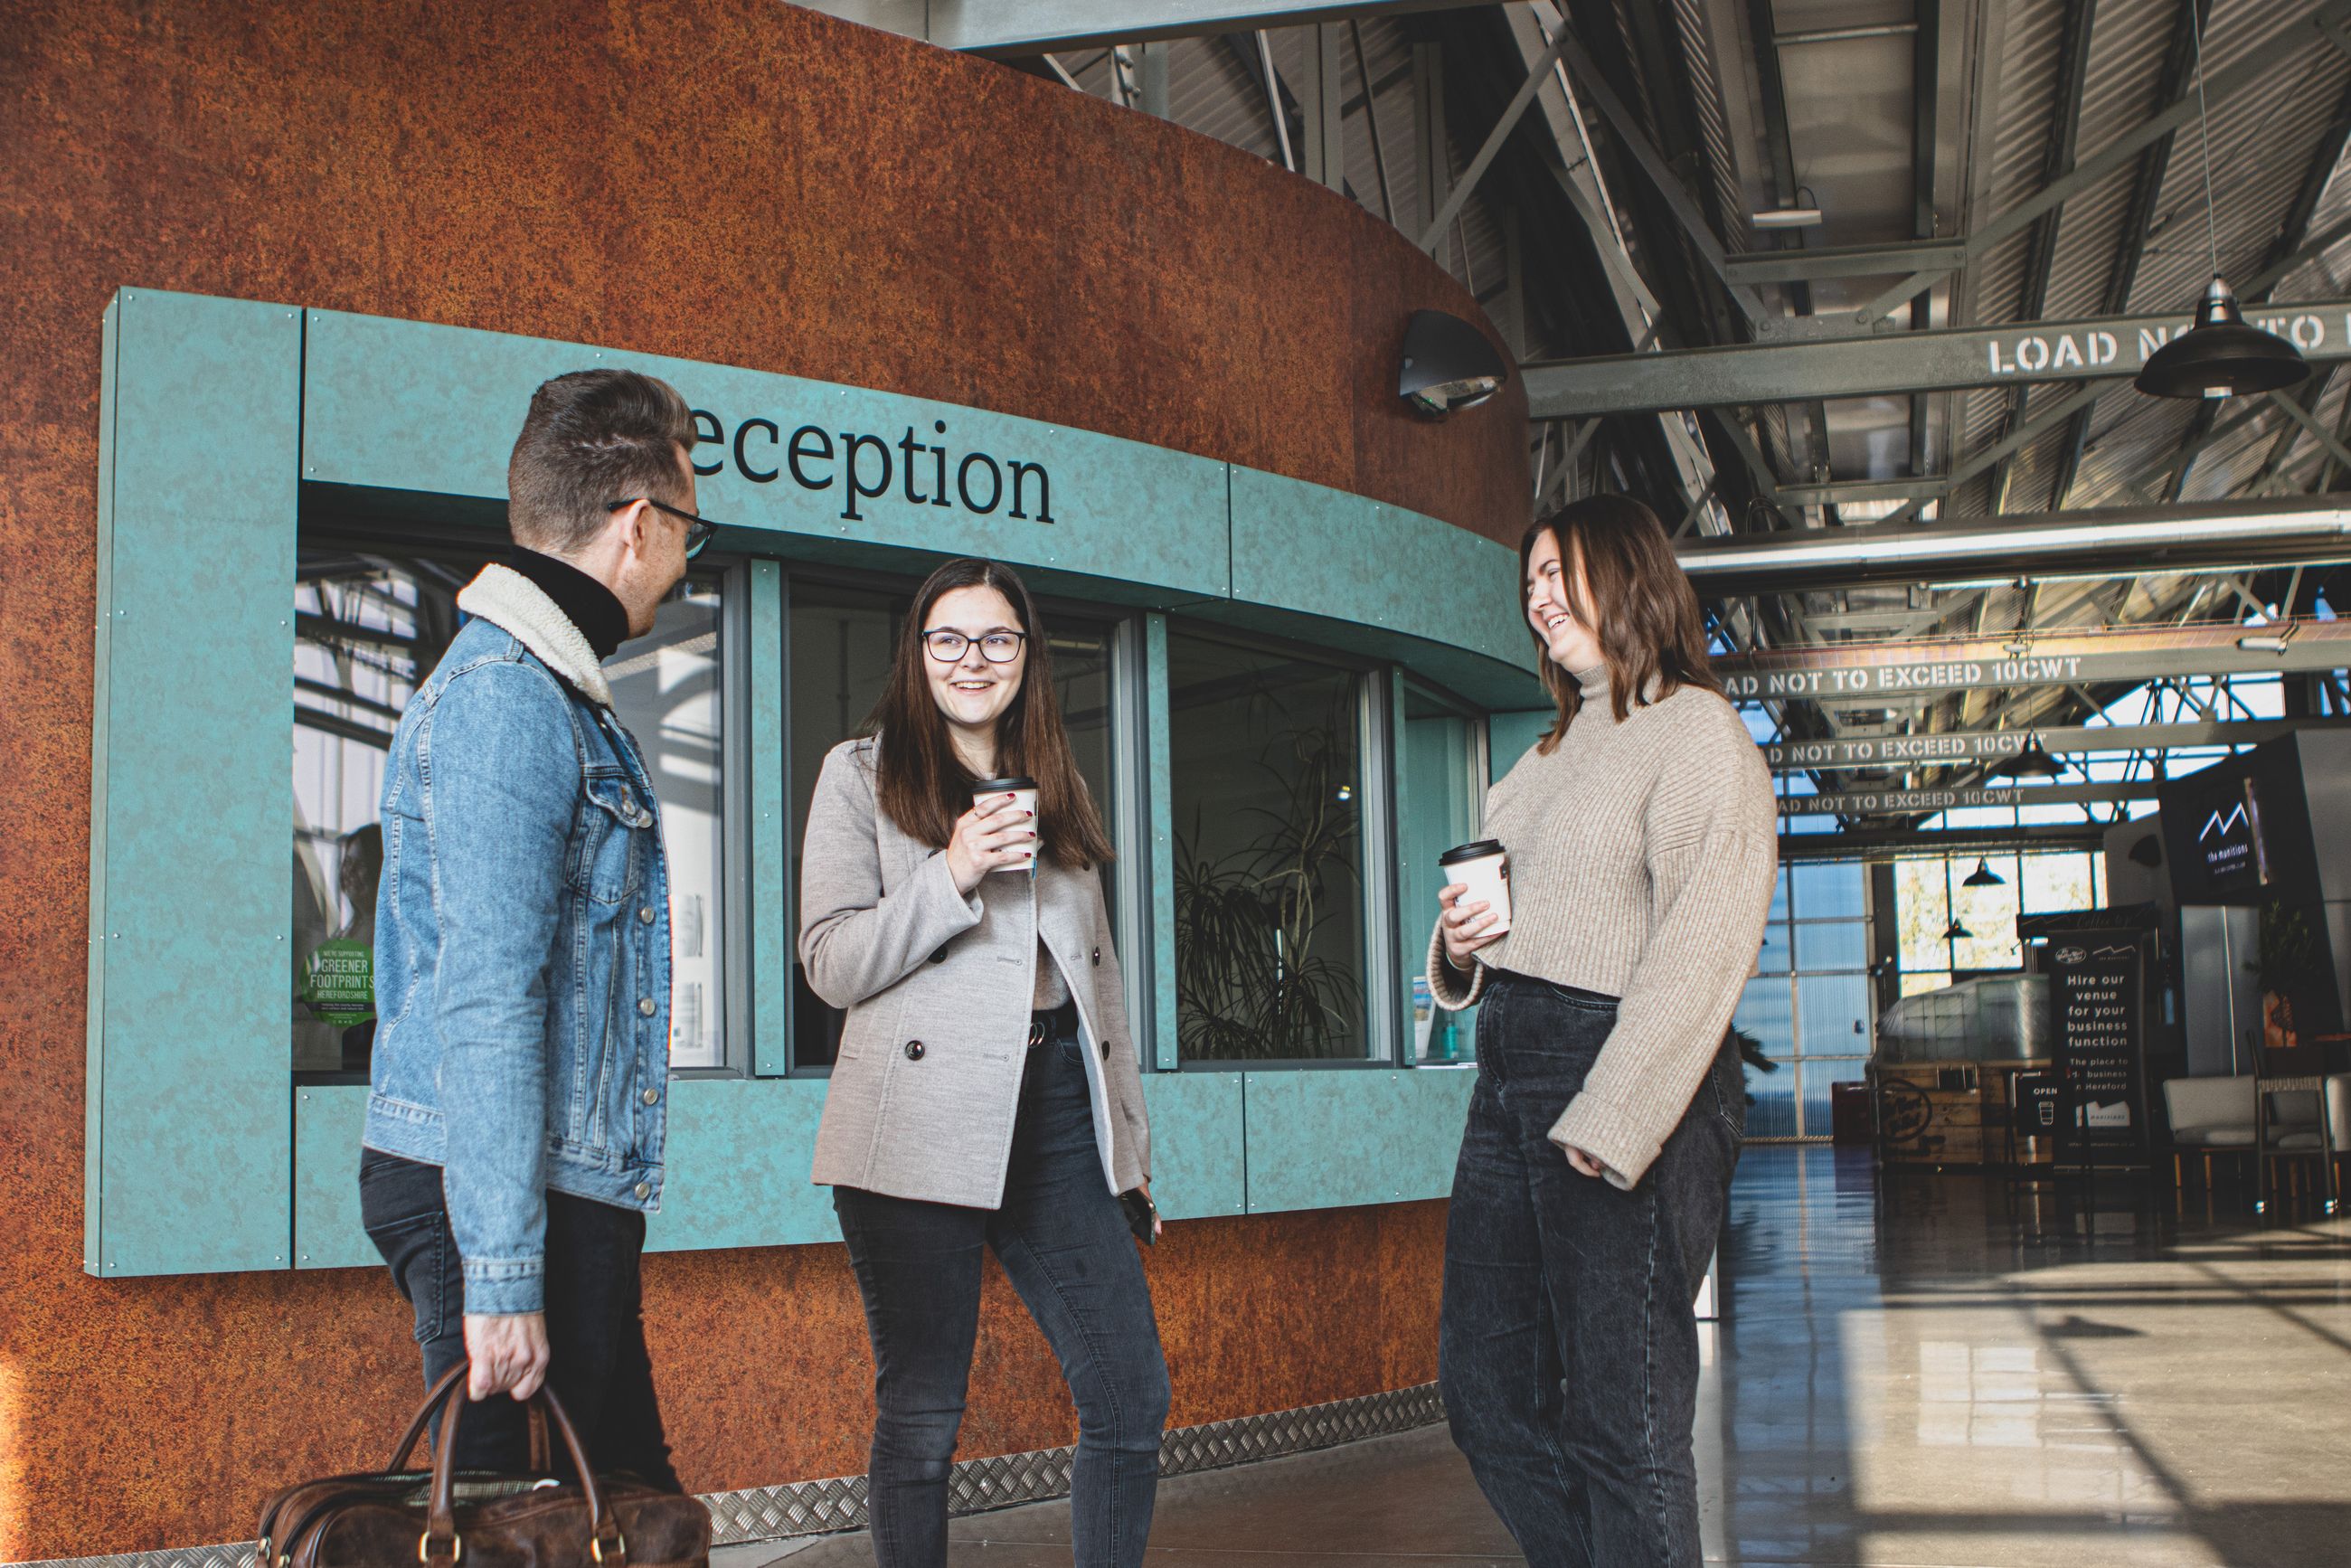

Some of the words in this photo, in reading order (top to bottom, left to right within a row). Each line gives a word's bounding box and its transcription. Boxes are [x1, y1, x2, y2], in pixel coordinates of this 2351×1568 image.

[1989, 331, 2119, 374] LOAD
[692, 409, 1054, 524] eception
[1725, 676, 1759, 695] AD
[1770, 673, 1823, 694] NOT
[1833, 669, 1869, 691] TO
[1879, 664, 1982, 688] EXCEED
[1992, 657, 2081, 681] 10CWT
[1792, 744, 1836, 762] NOT
[1845, 741, 1874, 760] TO
[1882, 738, 1966, 758] EXCEED
[1779, 799, 1801, 813] AD
[1809, 797, 1846, 811] NOT
[1853, 795, 1877, 810] TO
[1884, 792, 1956, 808] EXCEED
[1963, 789, 2025, 806] 10CWT
[321, 959, 368, 973] GREENER
[310, 974, 374, 989] FOOTPRINTS
[2067, 975, 2096, 986] Hire
[2101, 976, 2125, 985] our
[316, 989, 368, 999] HEREFORDSHIRE
[2076, 991, 2118, 1001] venue
[2068, 1006, 2089, 1015] for
[2094, 1006, 2126, 1018] your
[2067, 1021, 2128, 1032] business
[2068, 1036, 2128, 1047] function
[2070, 1057, 2087, 1066] The
[2091, 1057, 2116, 1067] place
[2087, 1071, 2128, 1079] business
[2033, 1087, 2058, 1095] OPEN
[2085, 1082, 2127, 1091] Hereford
